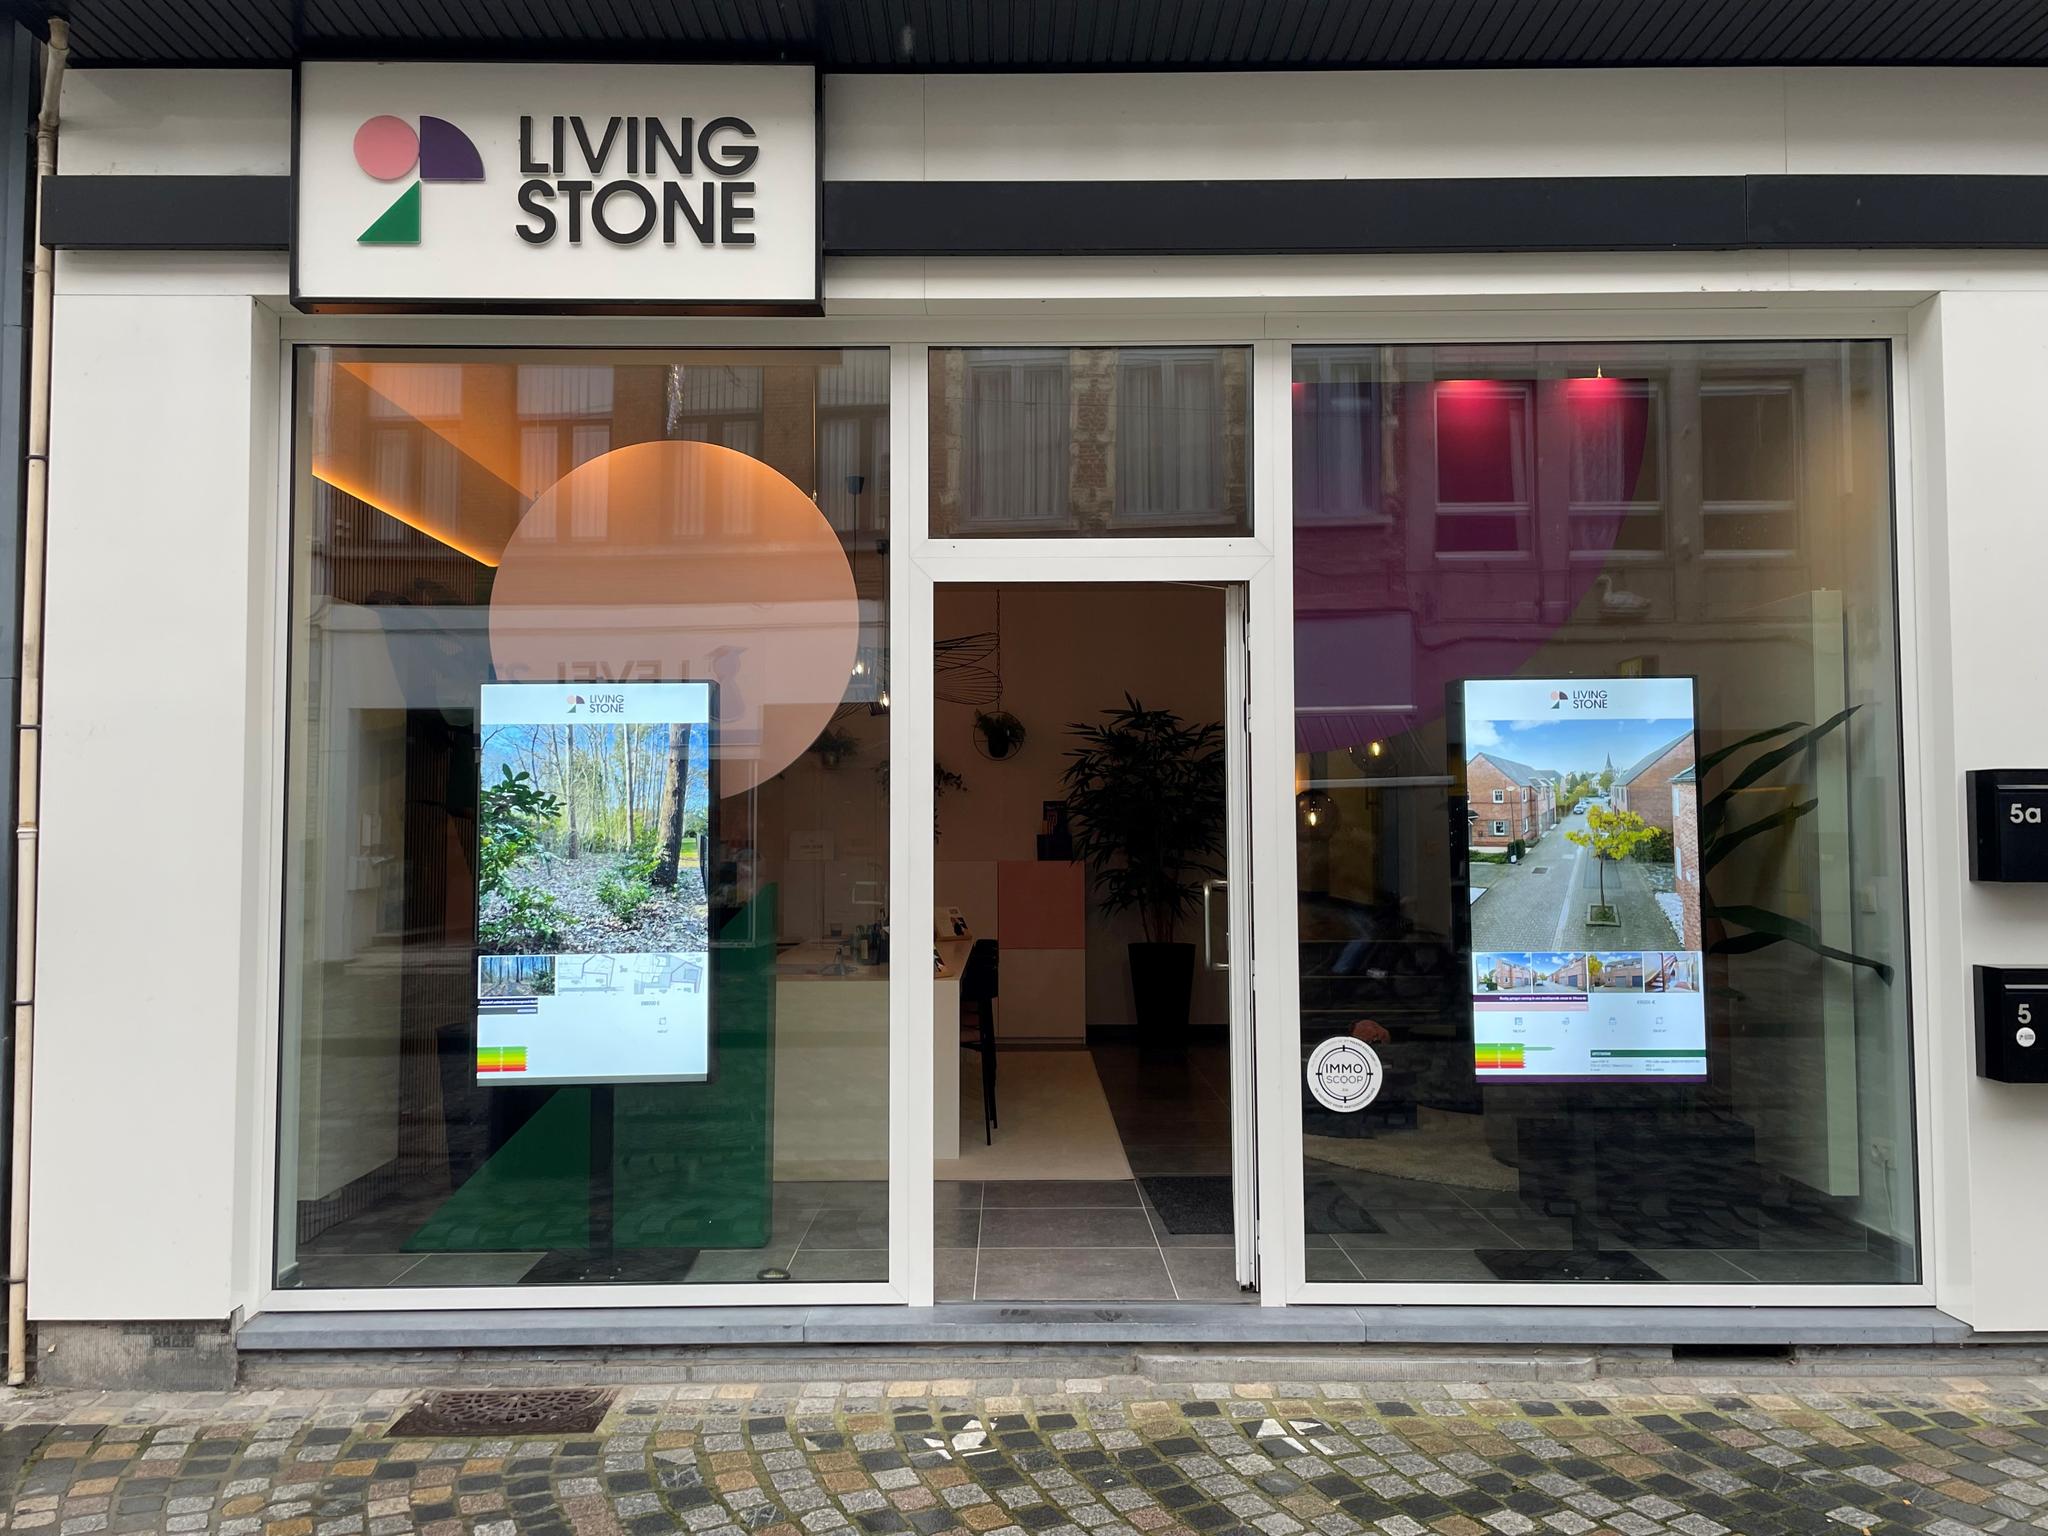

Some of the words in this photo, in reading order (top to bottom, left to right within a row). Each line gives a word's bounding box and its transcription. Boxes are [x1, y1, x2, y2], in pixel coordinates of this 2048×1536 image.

[520, 116, 759, 176] LIVING
[516, 179, 756, 244] STONE
[589, 694, 625, 703] LIVING
[1573, 690, 1608, 699] LIVING
[589, 703, 625, 713] STONE
[1573, 699, 1608, 709] STONE
[2010, 803, 2042, 824] 5a
[2017, 1003, 2032, 1024] 5
[1325, 1063, 1363, 1074] IMMO
[1326, 1075, 1364, 1085] SCOOP
